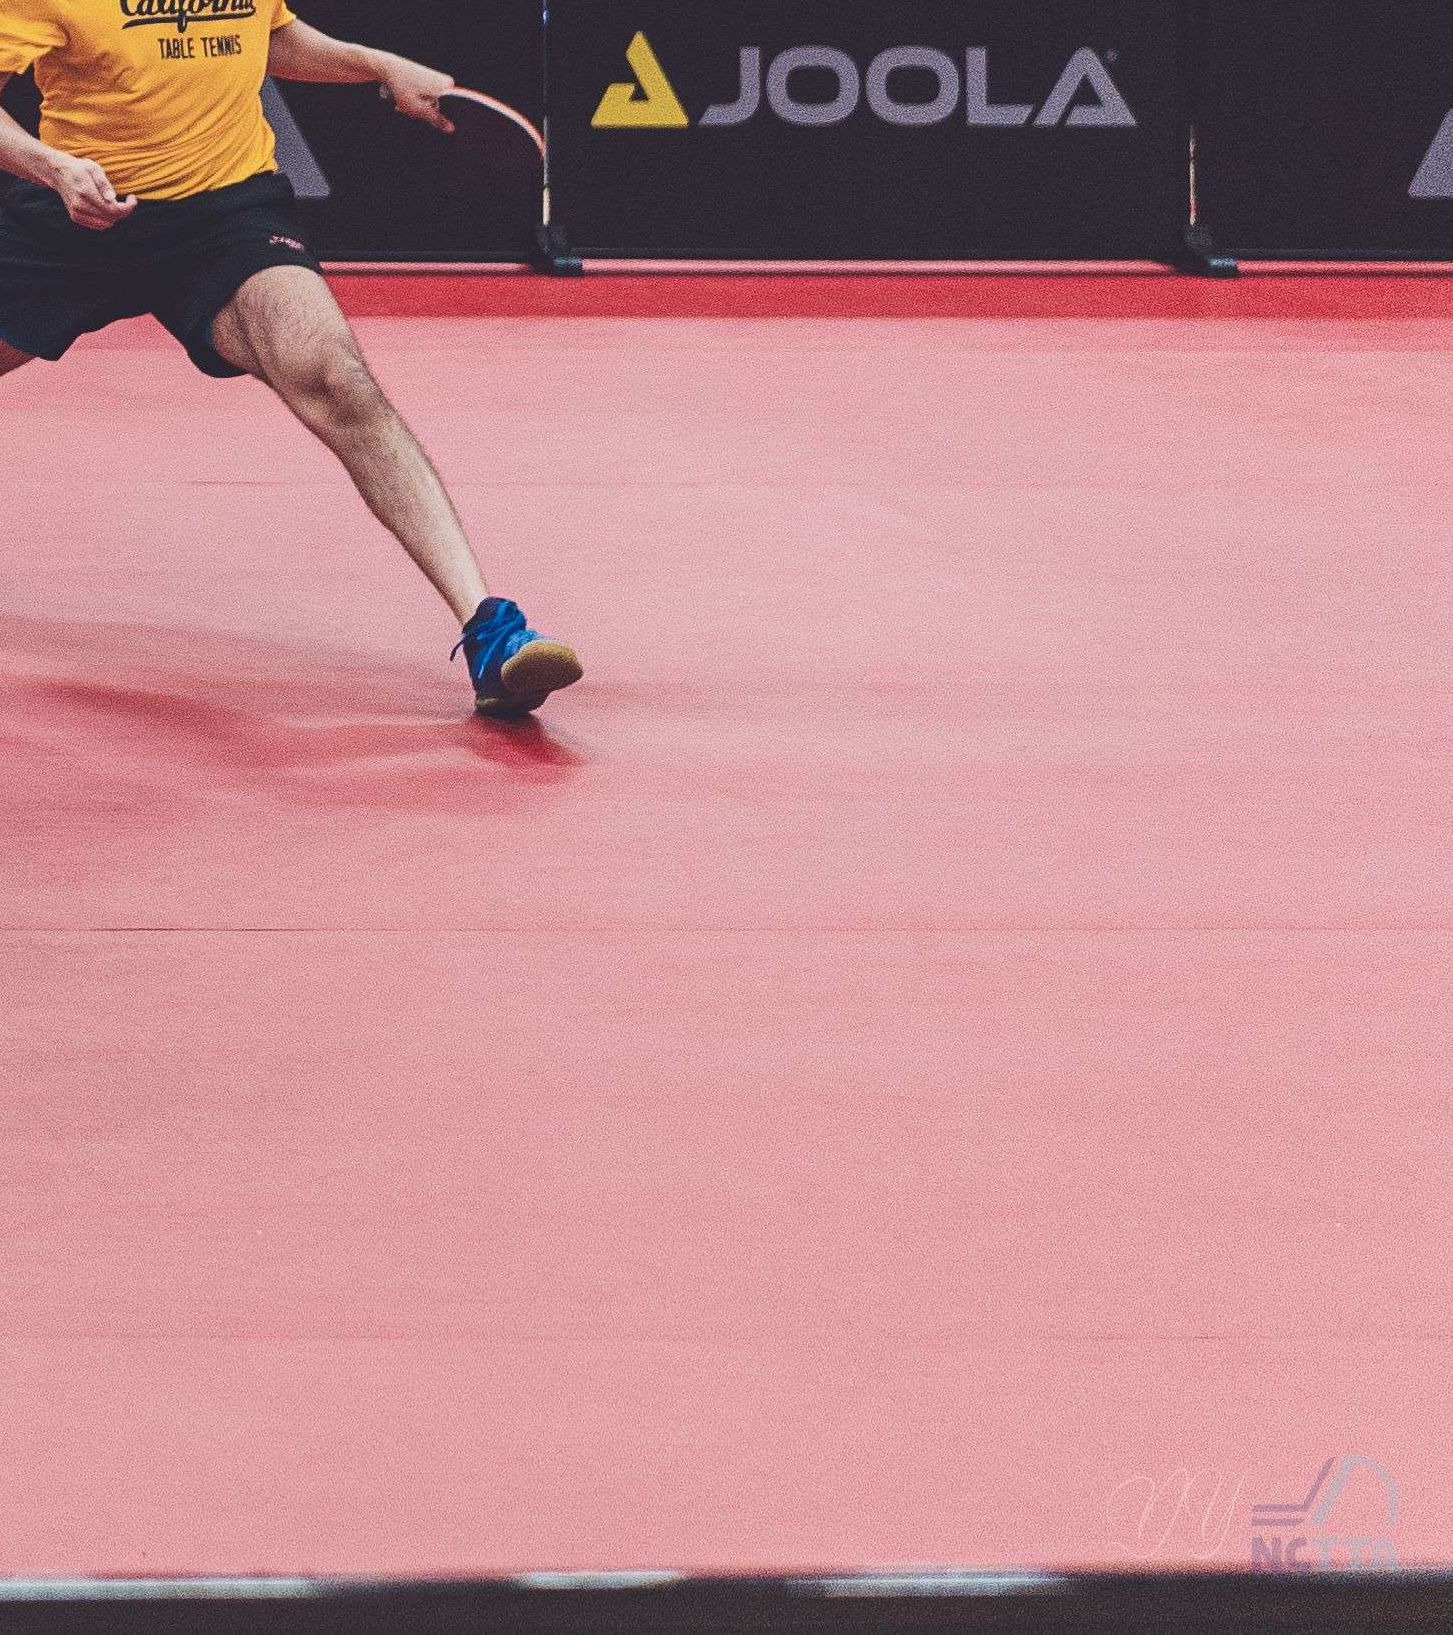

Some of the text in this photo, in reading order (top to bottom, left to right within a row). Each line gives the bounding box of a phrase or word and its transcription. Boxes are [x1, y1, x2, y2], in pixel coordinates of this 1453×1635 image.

[158, 34, 241, 59] TABLE TENNIS
[698, 45, 1137, 128] JOOLA
